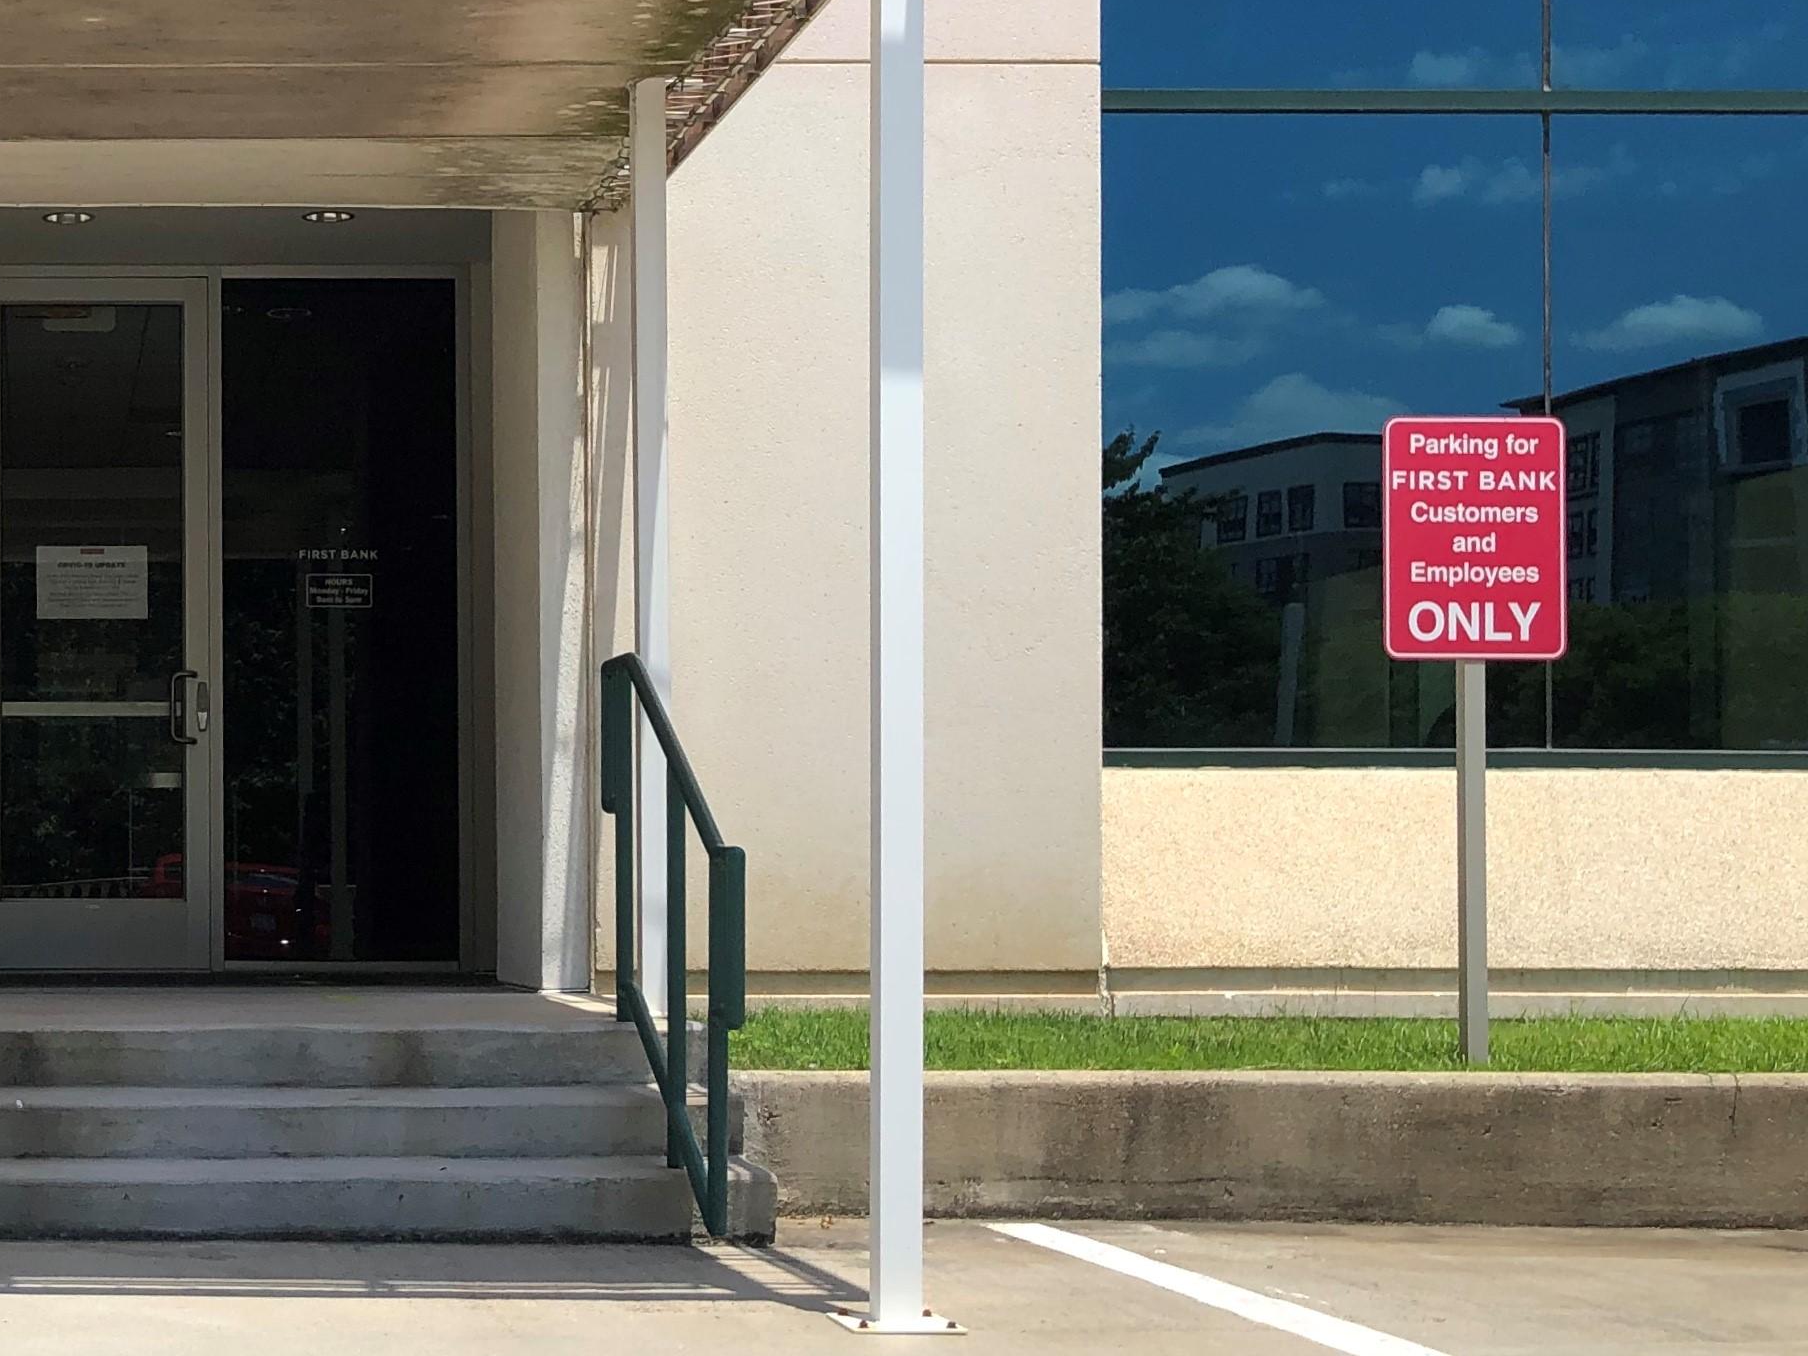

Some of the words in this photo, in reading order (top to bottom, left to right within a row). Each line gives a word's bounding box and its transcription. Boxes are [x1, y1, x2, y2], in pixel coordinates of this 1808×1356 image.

[1409, 433, 1498, 460] Parking
[1505, 433, 1539, 455] for
[1392, 470, 1469, 490] FIRST
[1479, 471, 1556, 491] BANK
[1410, 501, 1539, 523] Customers
[1452, 532, 1496, 553] and
[299, 549, 336, 560] FIRST
[340, 549, 379, 560] BANK
[324, 578, 353, 586] HOURS
[1410, 561, 1540, 588] Employees
[309, 587, 339, 595] Monday
[345, 587, 368, 596] Friday
[1408, 601, 1541, 642] ONLY
